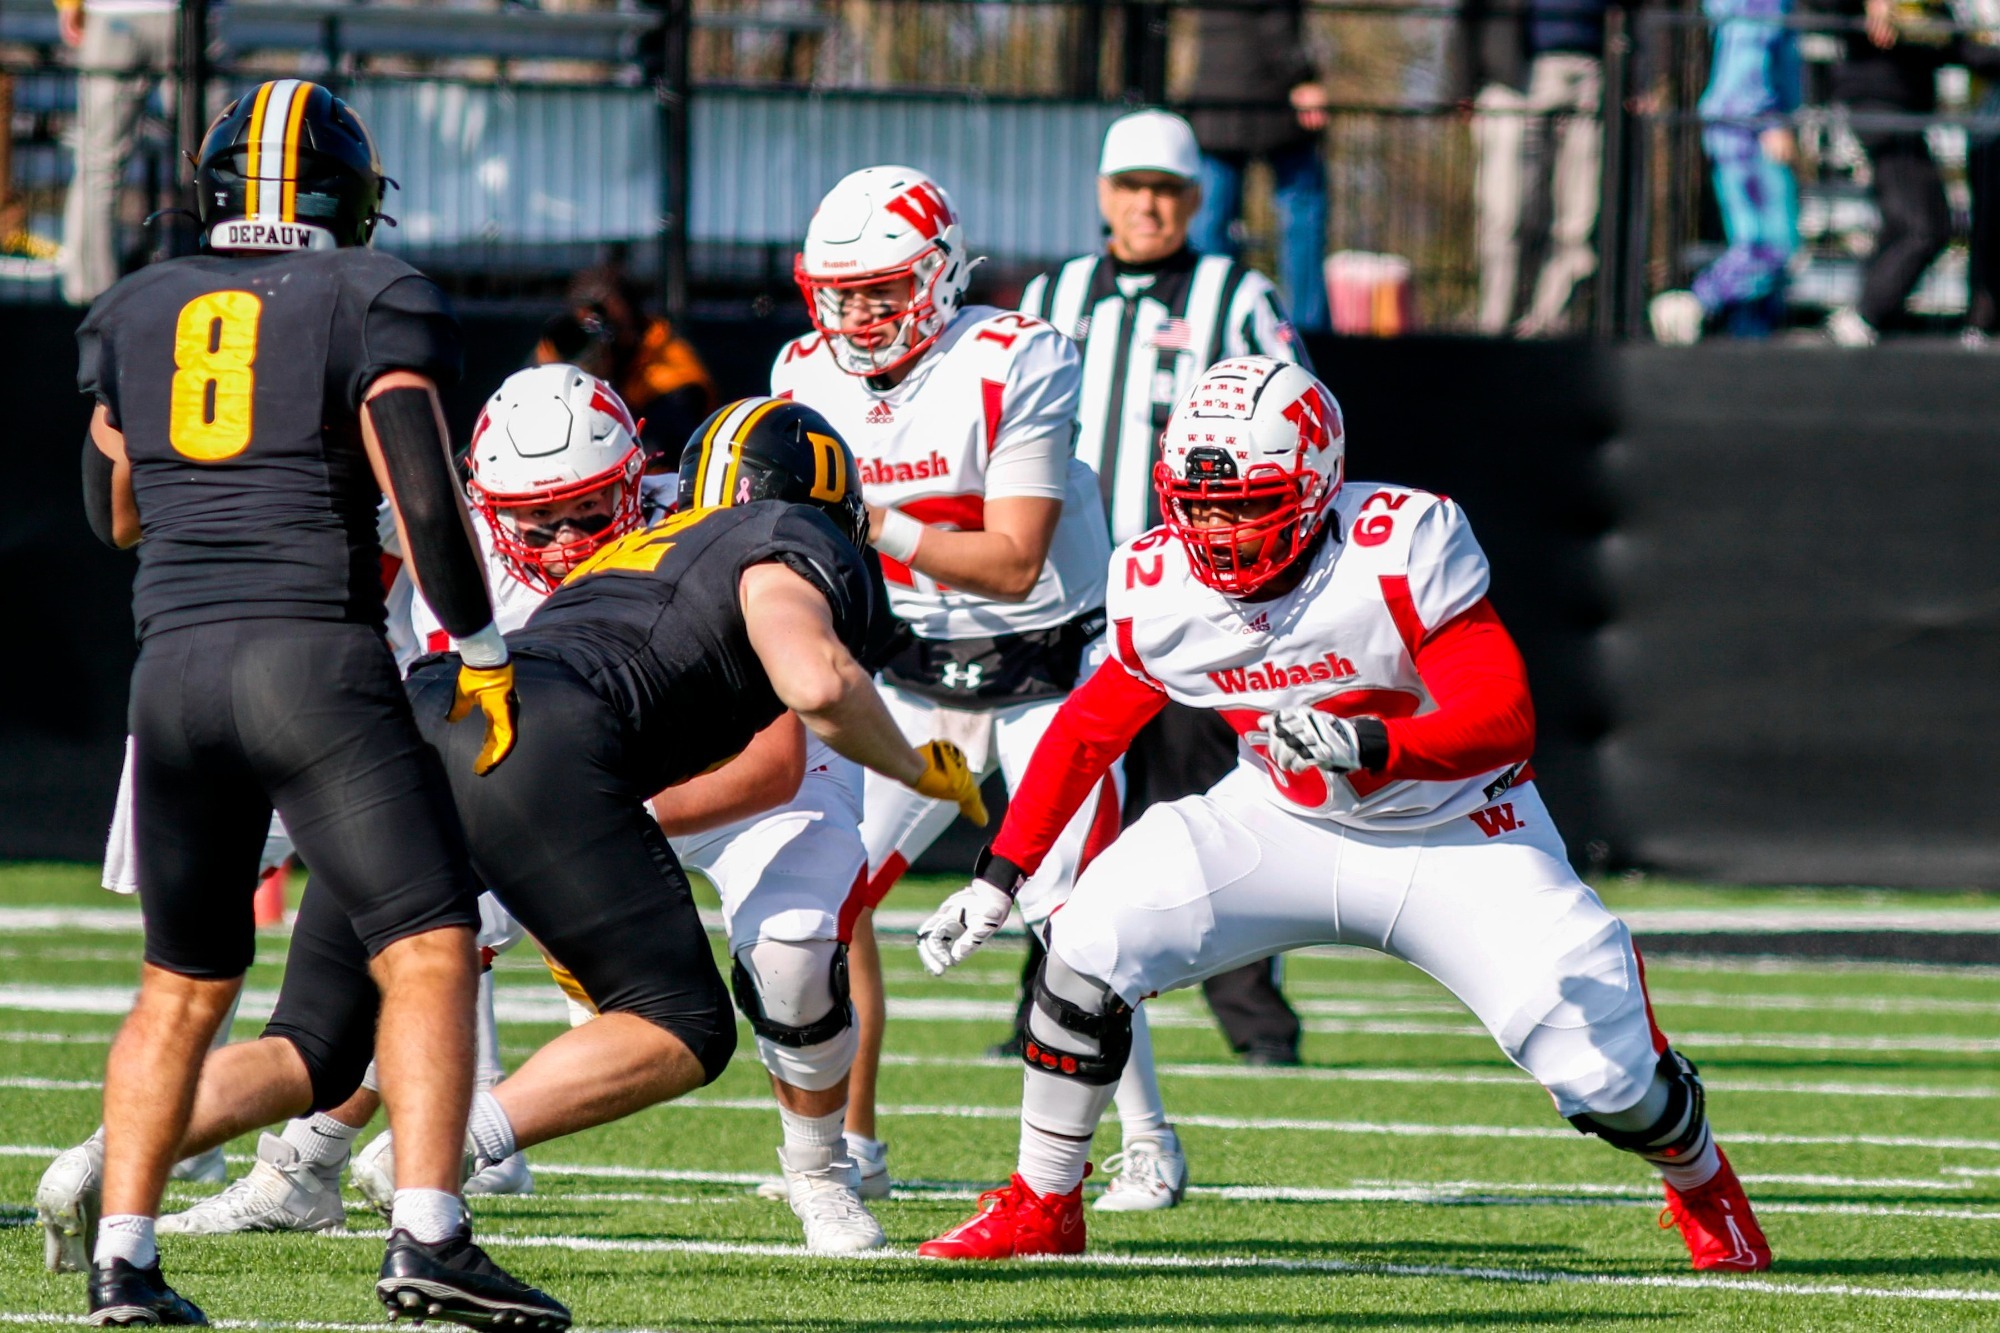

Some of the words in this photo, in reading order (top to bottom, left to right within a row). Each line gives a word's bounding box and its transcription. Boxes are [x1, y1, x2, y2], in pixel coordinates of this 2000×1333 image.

[228, 225, 311, 248] DEPAUW
[168, 289, 262, 461] 8
[807, 432, 847, 502] D
[855, 450, 950, 485] abash
[1352, 491, 1411, 547] 62
[1125, 528, 1172, 592] 62
[1206, 651, 1358, 695] Wabash
